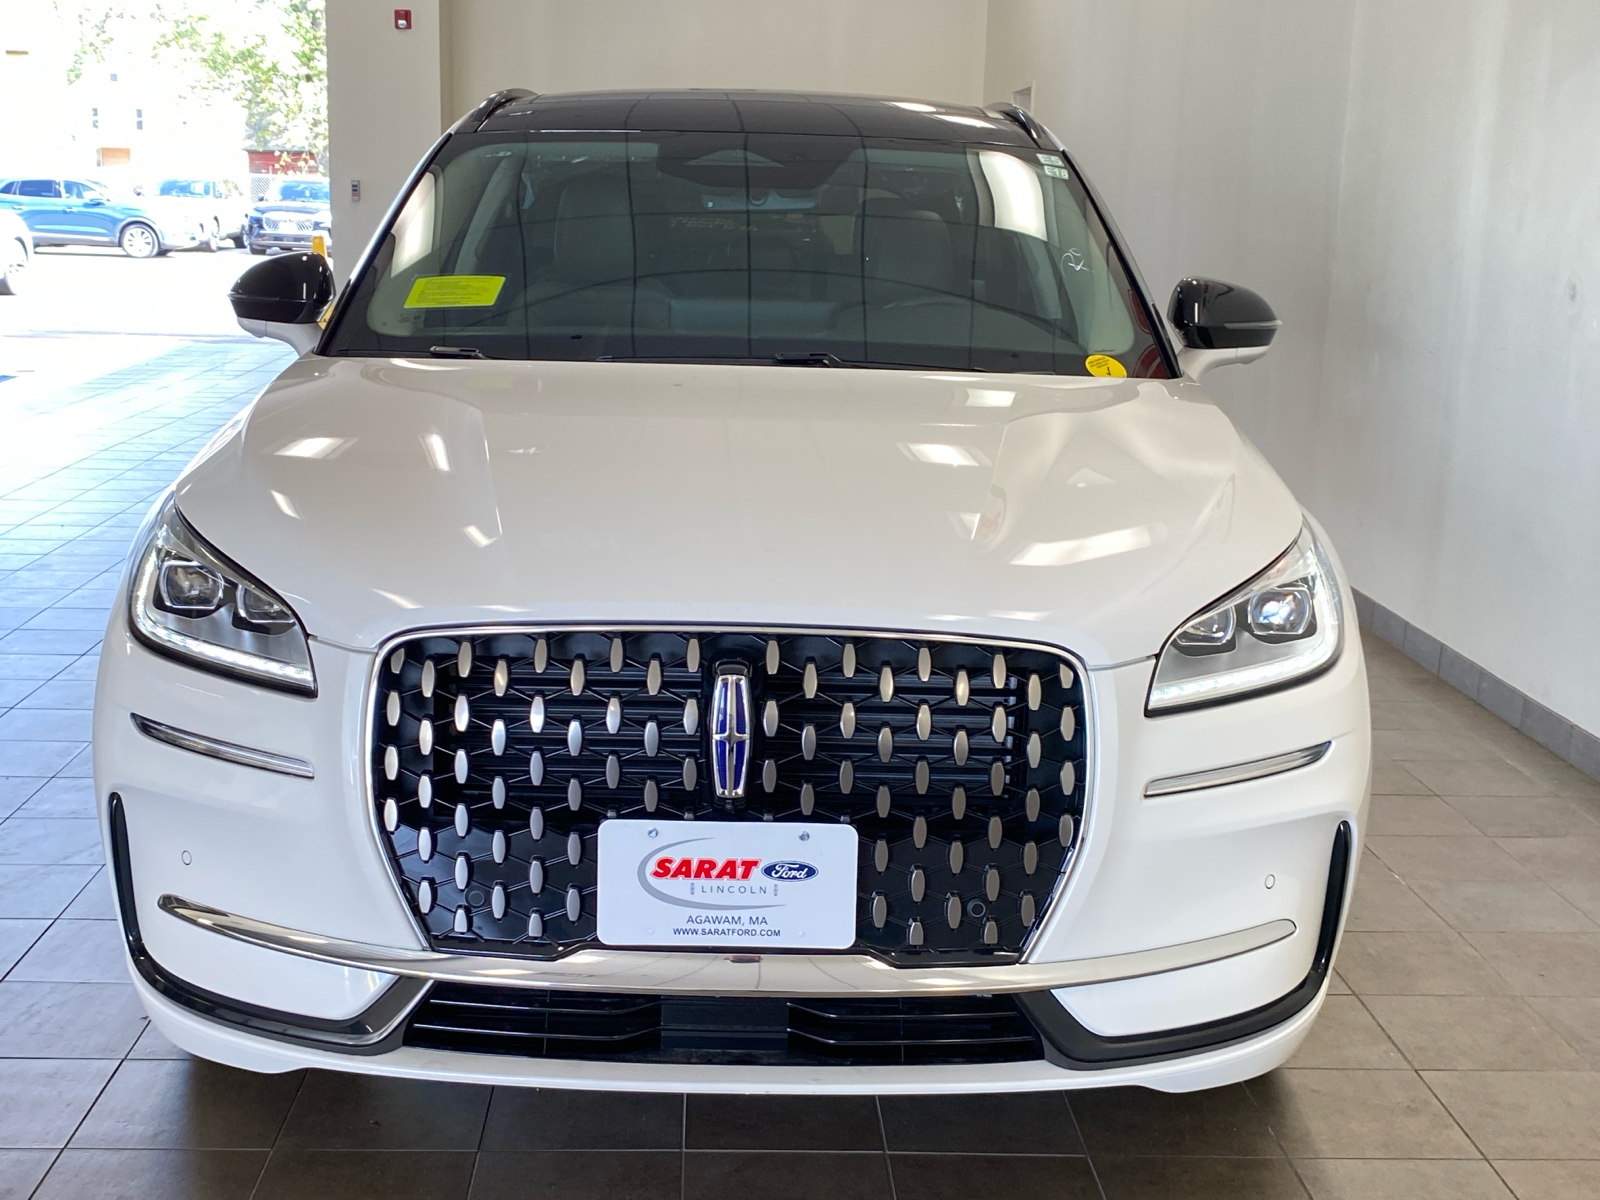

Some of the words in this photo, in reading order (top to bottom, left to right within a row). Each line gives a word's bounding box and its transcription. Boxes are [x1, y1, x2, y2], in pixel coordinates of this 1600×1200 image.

[1045, 166, 1068, 178] E18
[651, 857, 761, 880] SARAT
[771, 863, 808, 879] Ford
[701, 885, 767, 895] LINCOLN
[686, 915, 745, 926] AGAWAM,
[749, 916, 768, 926] MA
[673, 927, 781, 937] WWW.SARATFORD.COM
